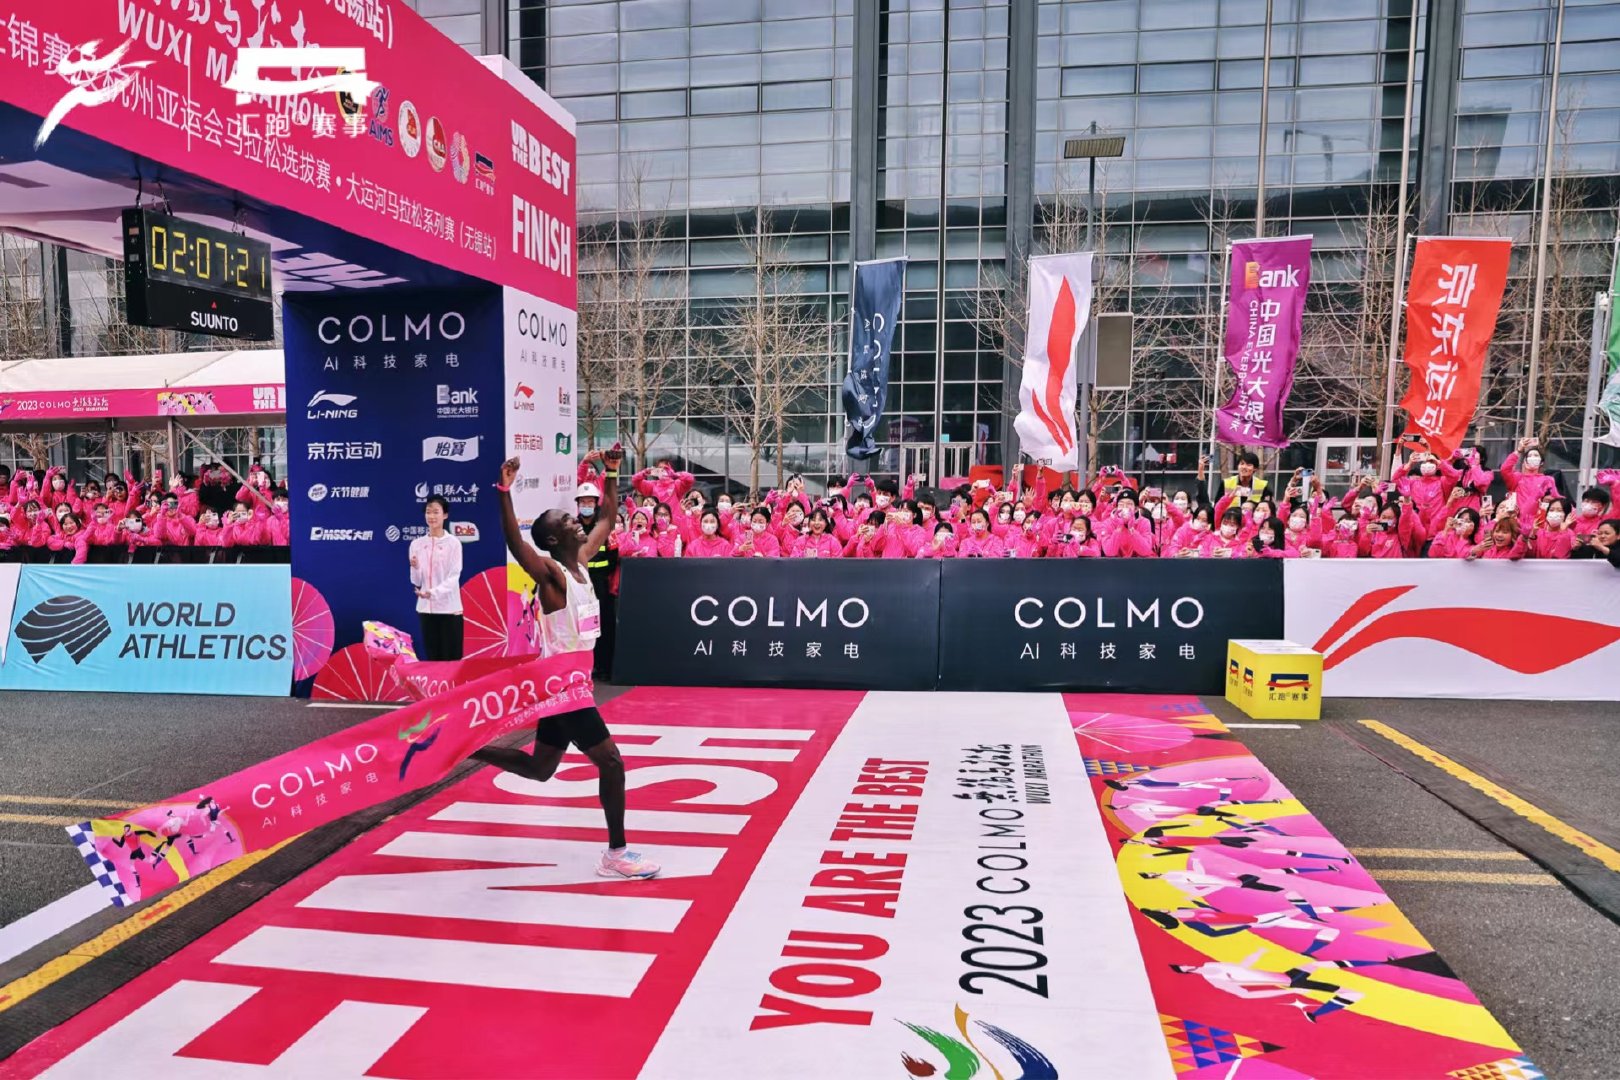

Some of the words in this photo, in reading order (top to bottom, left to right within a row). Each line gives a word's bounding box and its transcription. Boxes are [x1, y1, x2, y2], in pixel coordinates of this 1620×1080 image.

[117, 0, 195, 67] WUXI
[369, 119, 394, 148] AIMS
[510, 119, 528, 151] UR
[511, 144, 529, 169] THE
[528, 133, 570, 196] BEST
[512, 194, 571, 278] FINISH
[152, 226, 266, 290] 02:07:21
[1244, 261, 1300, 288] Bank
[190, 311, 238, 332] SUUNTO
[318, 311, 466, 344] COLMO
[518, 308, 568, 347] COLMO
[1248, 300, 1259, 338] CHINA
[324, 356, 339, 371] AI
[17, 400, 38, 411] 2023
[39, 400, 71, 409] COLMO
[252, 387, 276, 400] UR
[252, 400, 276, 410] THE
[307, 409, 358, 420] LI-NING
[307, 441, 382, 460] 京东运动
[454, 525, 476, 537] Dole
[127, 602, 236, 627] WORLD
[690, 595, 869, 628] COLMO
[1014, 597, 1204, 628] COLMO
[118, 634, 287, 661] ATHLETICS
[694, 640, 712, 655] AI
[731, 639, 860, 659] 科技家电
[1020, 642, 1039, 660] AI
[1060, 642, 1196, 660] 科技家电
[463, 679, 539, 728] 2023
[251, 743, 378, 809] COLMO
[851, 757, 930, 797] BEST
[1021, 744, 1048, 781] MARATHON
[262, 816, 277, 829] AI
[290, 772, 378, 817] 科技家电
[1025, 782, 1051, 804] WUXI
[829, 802, 919, 841] THE
[976, 808, 1030, 894] COLMO
[801, 850, 908, 918] ARE
[27, 723, 817, 1080] FINISH
[958, 904, 1049, 999] 2023
[749, 929, 890, 1031] YOU
